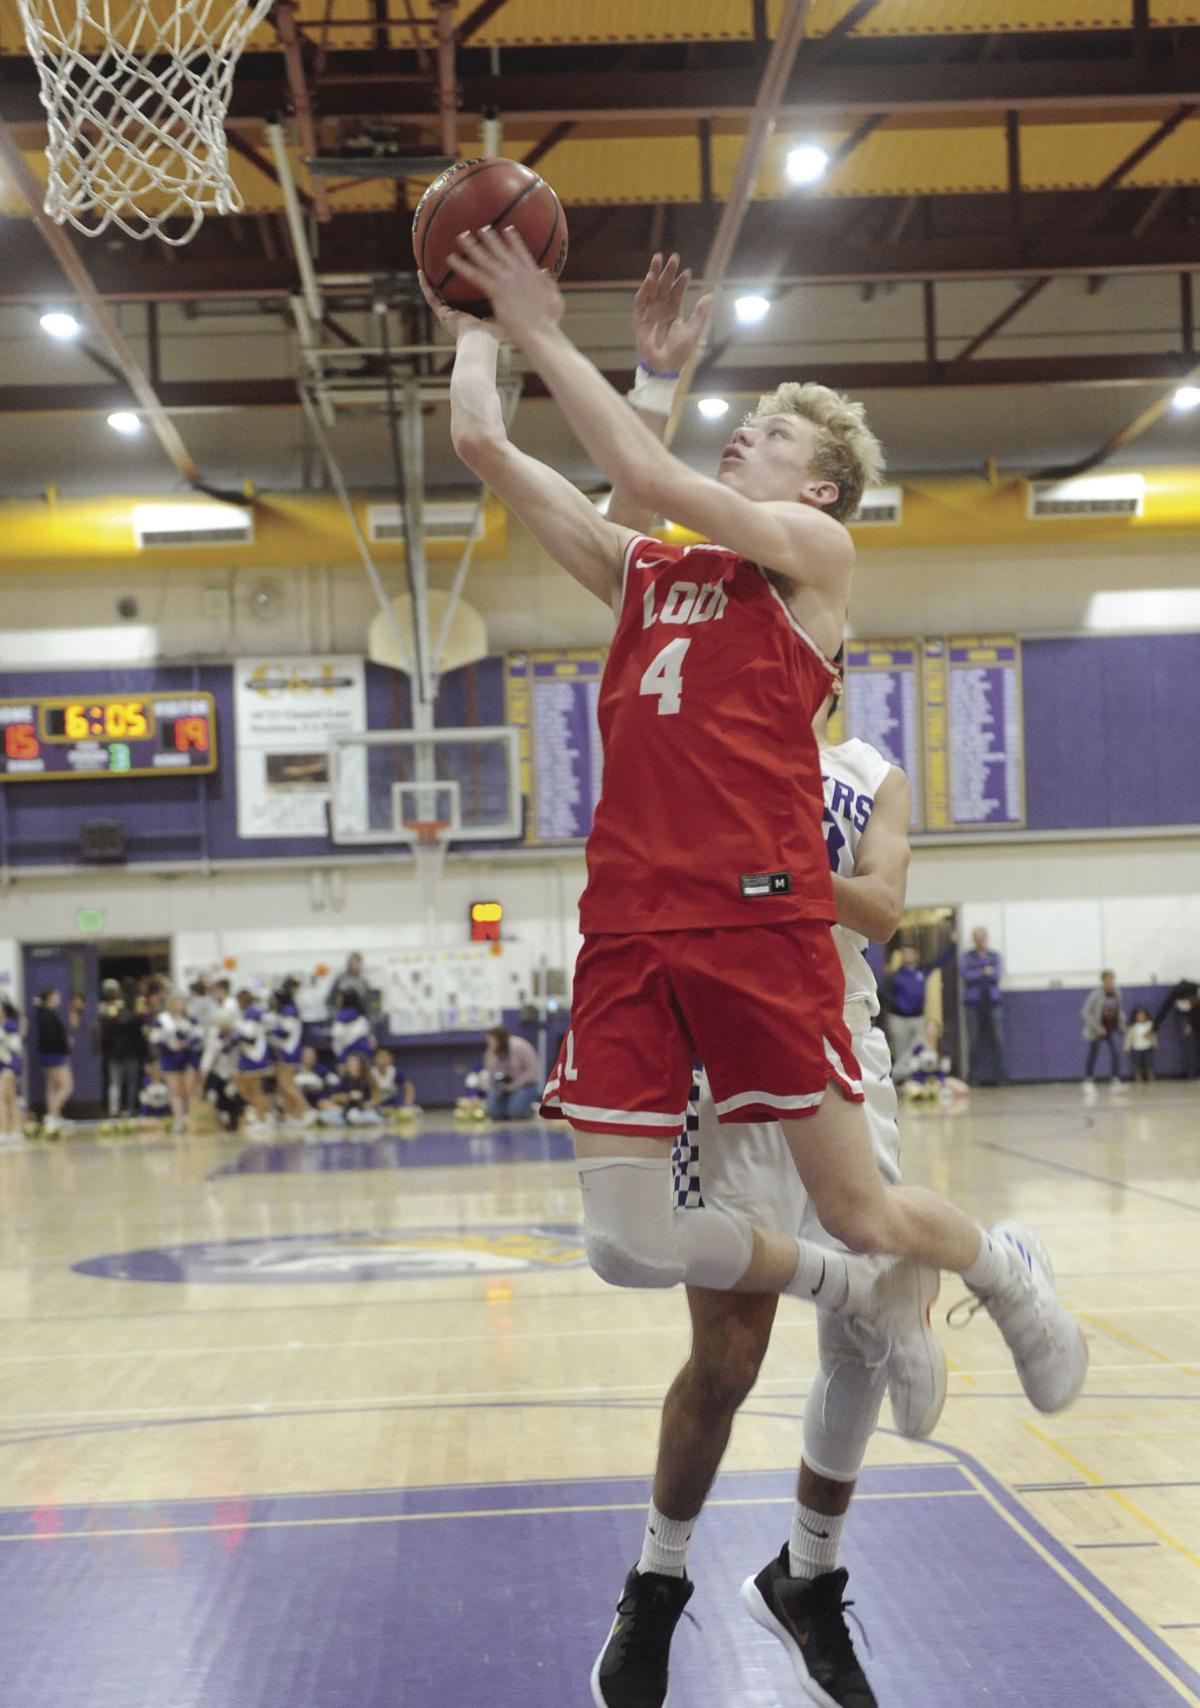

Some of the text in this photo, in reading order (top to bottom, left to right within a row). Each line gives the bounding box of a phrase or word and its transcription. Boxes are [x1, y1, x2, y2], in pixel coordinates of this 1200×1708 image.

[642, 577, 729, 630] LODI
[639, 637, 692, 715] 4
[64, 703, 148, 738] 6:05
[823, 775, 875, 833] RS
